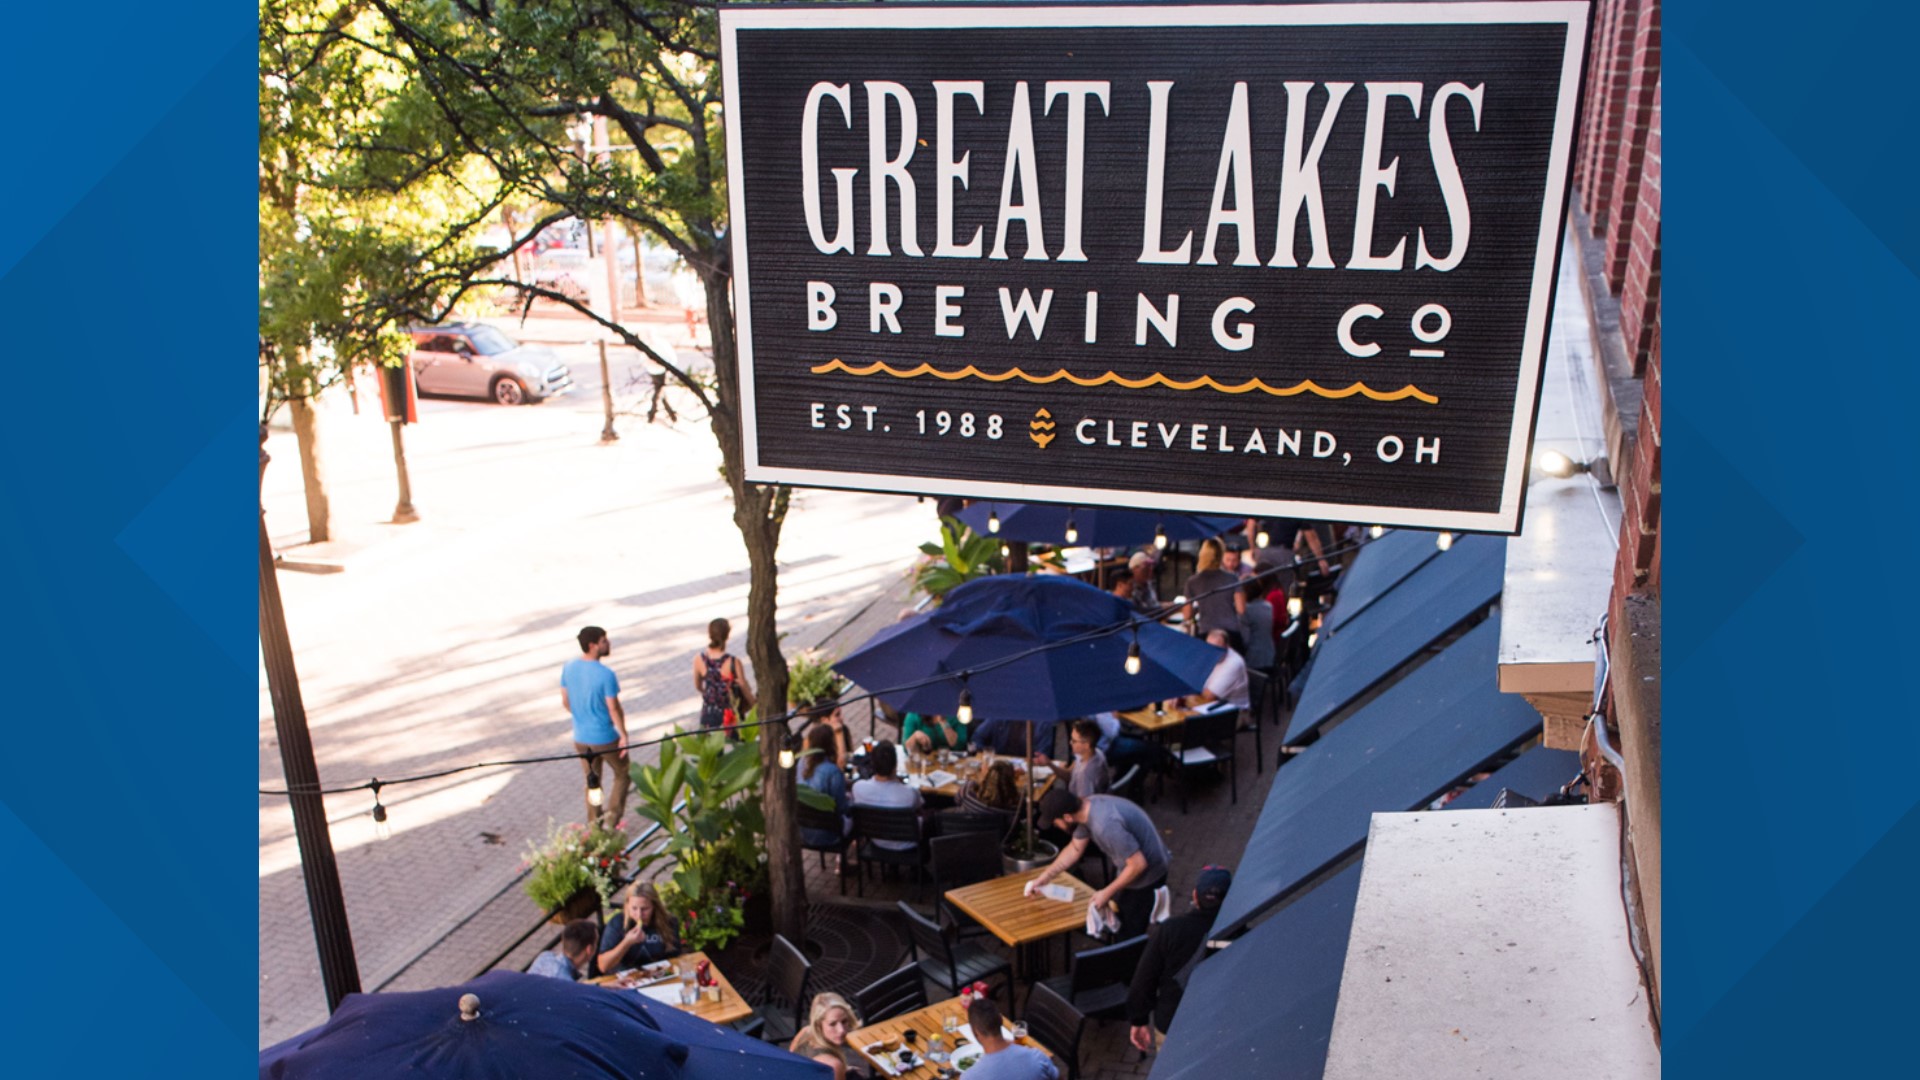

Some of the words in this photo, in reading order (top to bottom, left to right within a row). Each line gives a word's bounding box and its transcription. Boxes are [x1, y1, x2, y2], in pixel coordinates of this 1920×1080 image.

[802, 81, 1110, 261] GREAT
[1137, 81, 1485, 271] LAKES
[807, 281, 1255, 350] BREWING
[811, 403, 890, 432] EST.
[917, 410, 1002, 439] 1988
[1076, 419, 1351, 465] CLEVELAND,
[1377, 436, 1439, 463] OH
